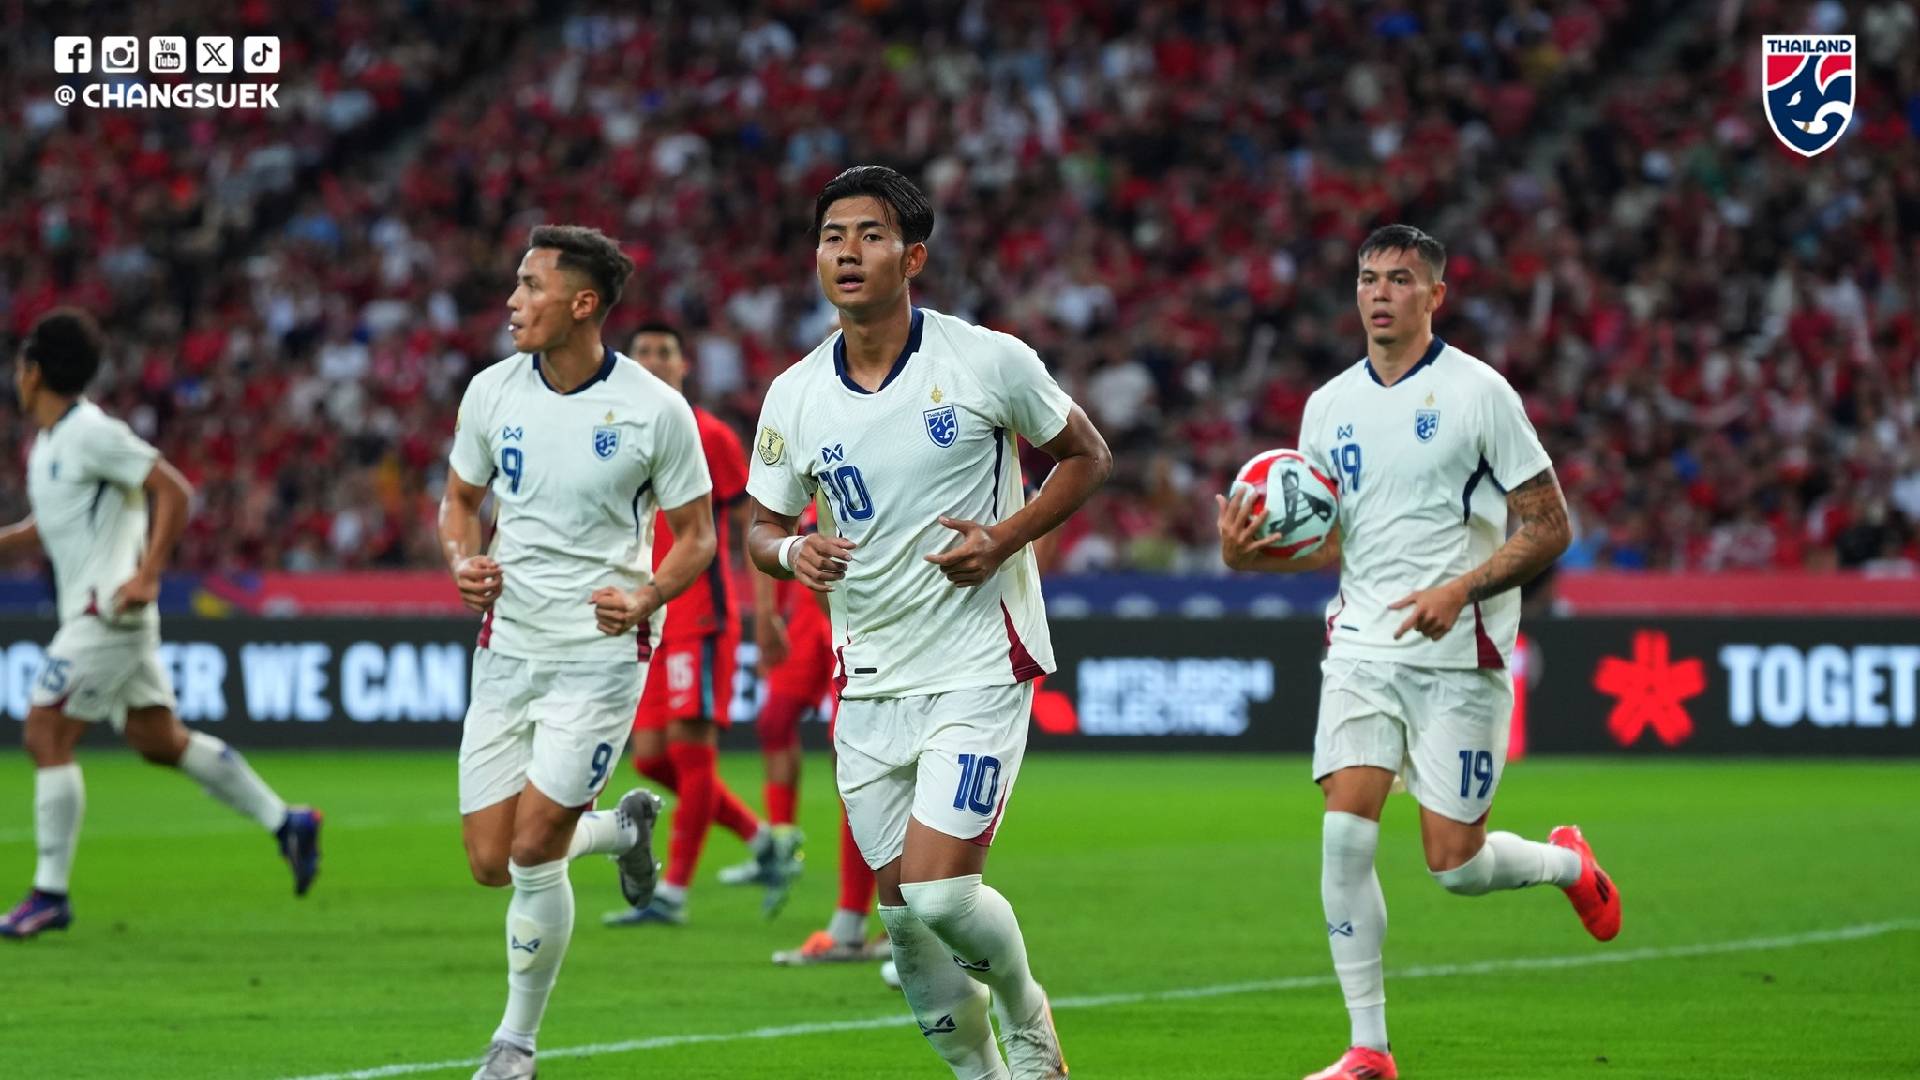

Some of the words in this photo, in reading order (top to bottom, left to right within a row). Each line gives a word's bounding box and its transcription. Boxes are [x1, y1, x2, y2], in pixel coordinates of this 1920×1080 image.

[501, 447, 523, 494] 9
[818, 465, 875, 523] 10
[1331, 443, 1361, 496] 19
[239, 642, 333, 722] WE
[341, 641, 468, 722] CAN
[589, 742, 613, 790] 9
[953, 753, 1001, 816] 10
[1459, 750, 1494, 798] 19
